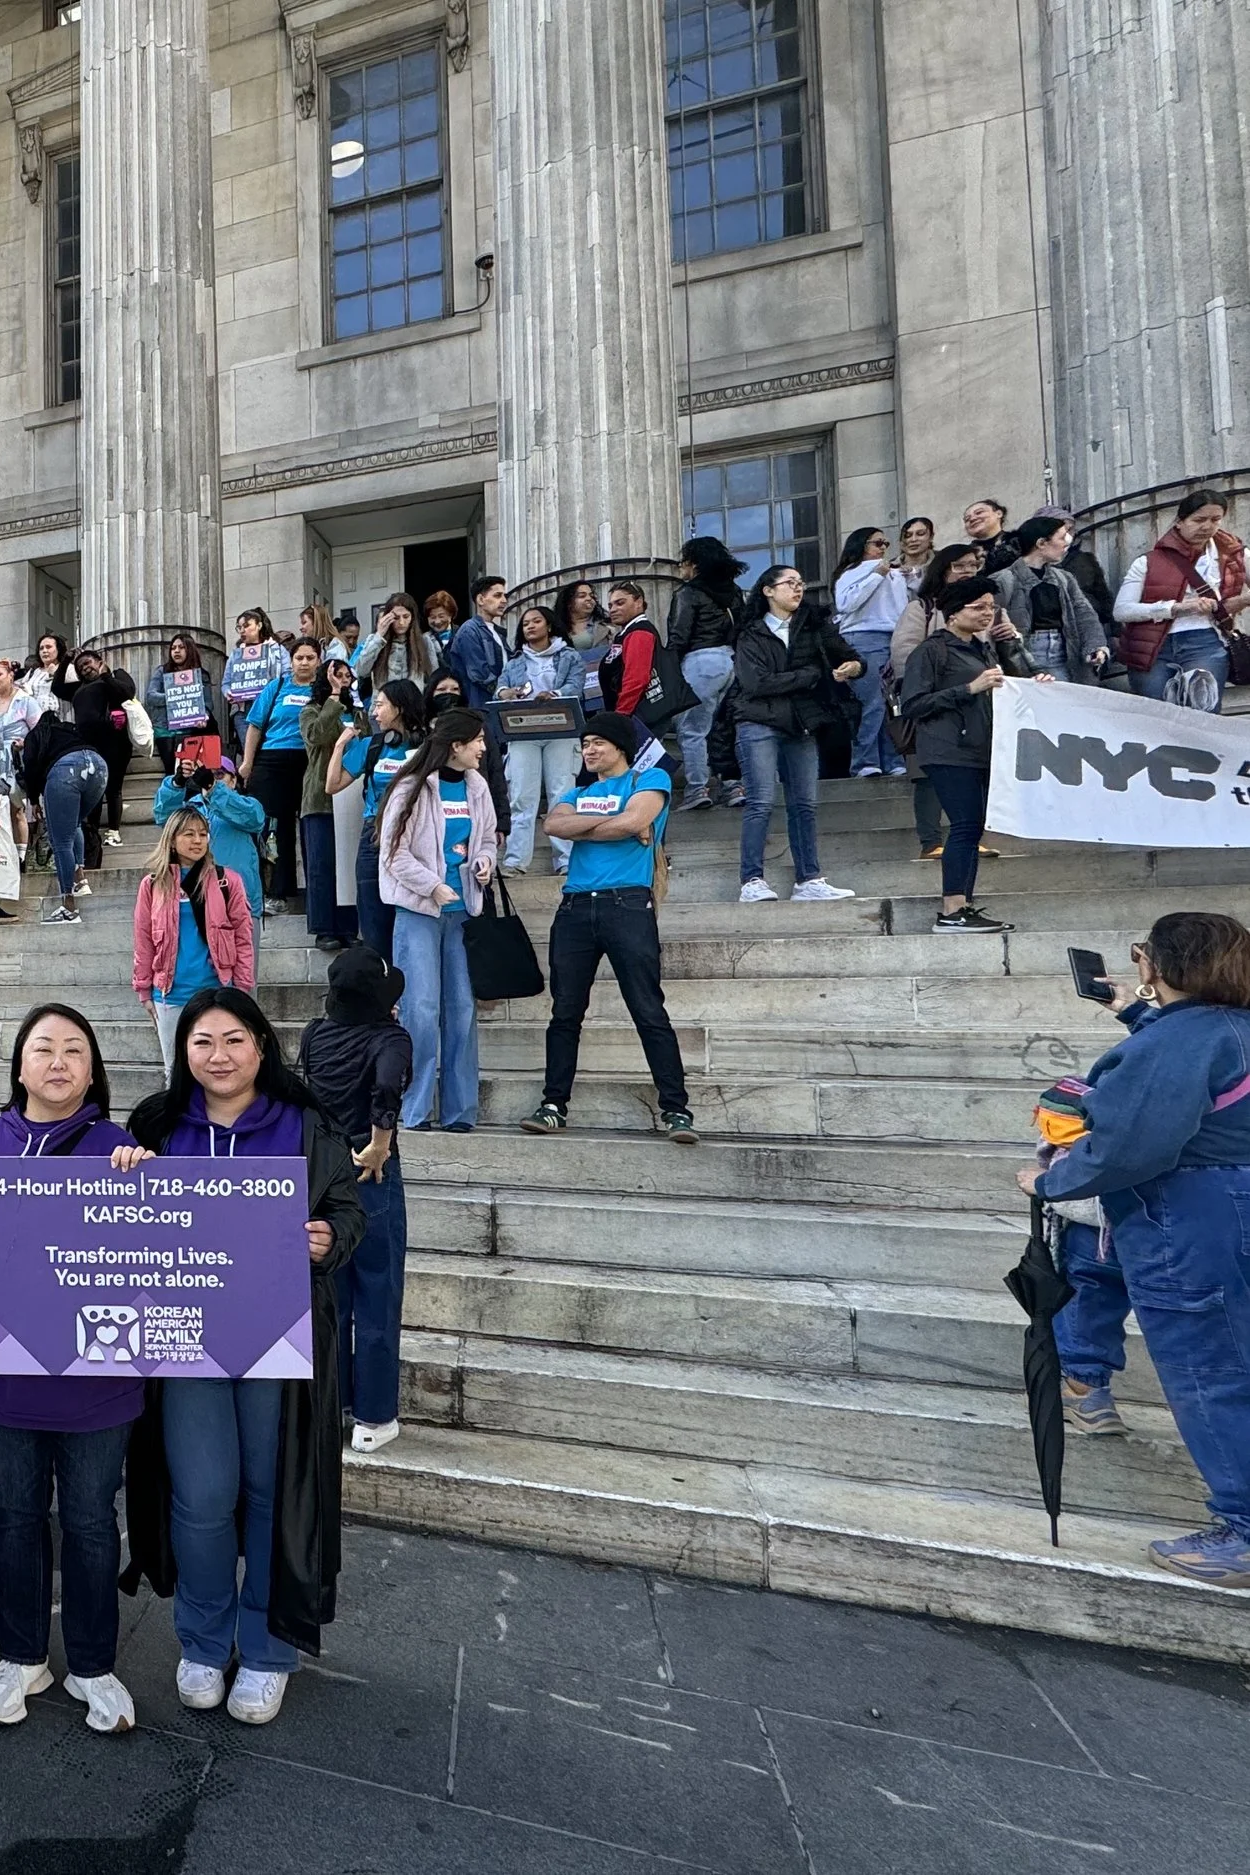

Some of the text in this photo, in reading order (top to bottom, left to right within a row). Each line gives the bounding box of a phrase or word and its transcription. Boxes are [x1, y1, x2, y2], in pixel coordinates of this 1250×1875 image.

[233, 660, 267, 673] ROMPE
[244, 671, 256, 680] EL
[167, 684, 201, 697] IT'S NOT
[231, 679, 268, 690] SILENCIO
[167, 691, 202, 702] ABOUT WHAT
[176, 700, 192, 709] YOU
[172, 707, 199, 718] WEAR
[1015, 728, 1221, 802] NYC
[66, 1177, 137, 1197] Hotline
[147, 1178, 295, 1197] 718-460-3800
[83, 1205, 193, 1227] KAFSC.org
[45, 1246, 234, 1269] Transforming Lives.
[54, 1269, 225, 1288] You are not alone.
[144, 1305, 203, 1319] KOREAN
[144, 1318, 203, 1329] AMERICAN
[144, 1329, 204, 1344] FAMILY
